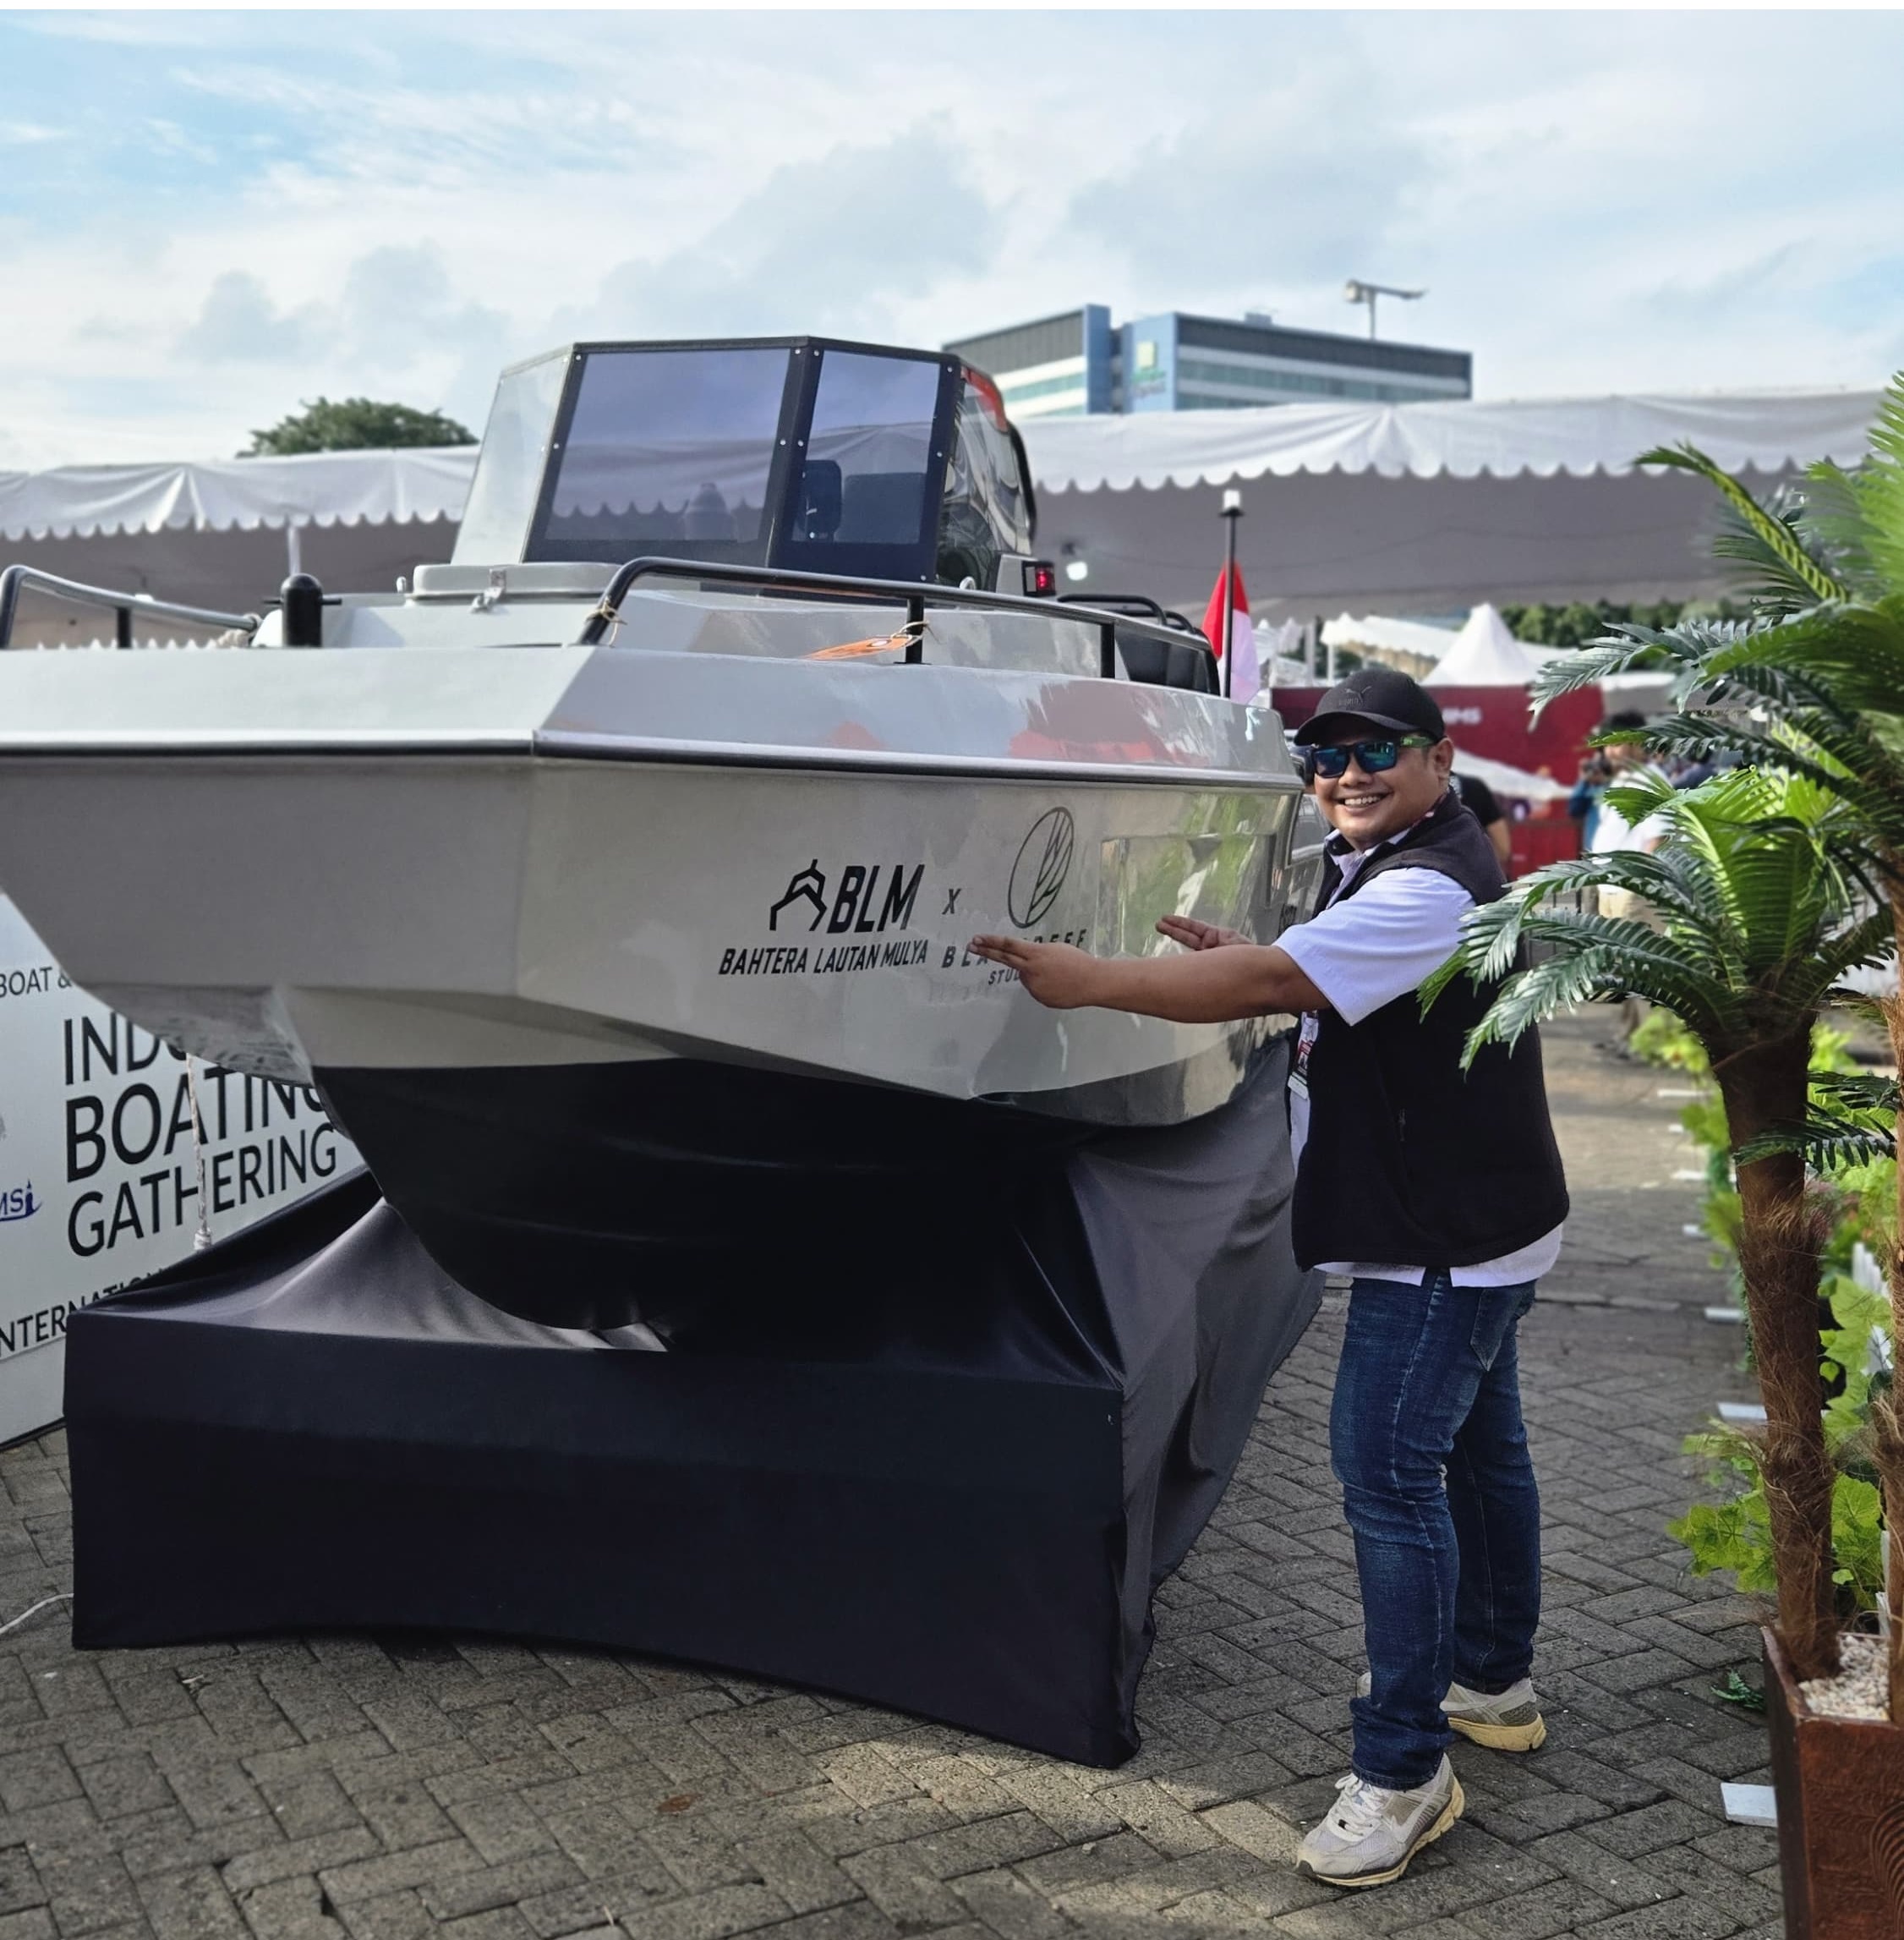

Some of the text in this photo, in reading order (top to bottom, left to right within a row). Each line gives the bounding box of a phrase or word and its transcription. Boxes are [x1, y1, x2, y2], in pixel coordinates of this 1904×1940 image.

[827, 864, 925, 934] BLM
[718, 940, 929, 975] BAHTERA LAUTAN MULYA
[68, 1122, 336, 1257] GATHERING
